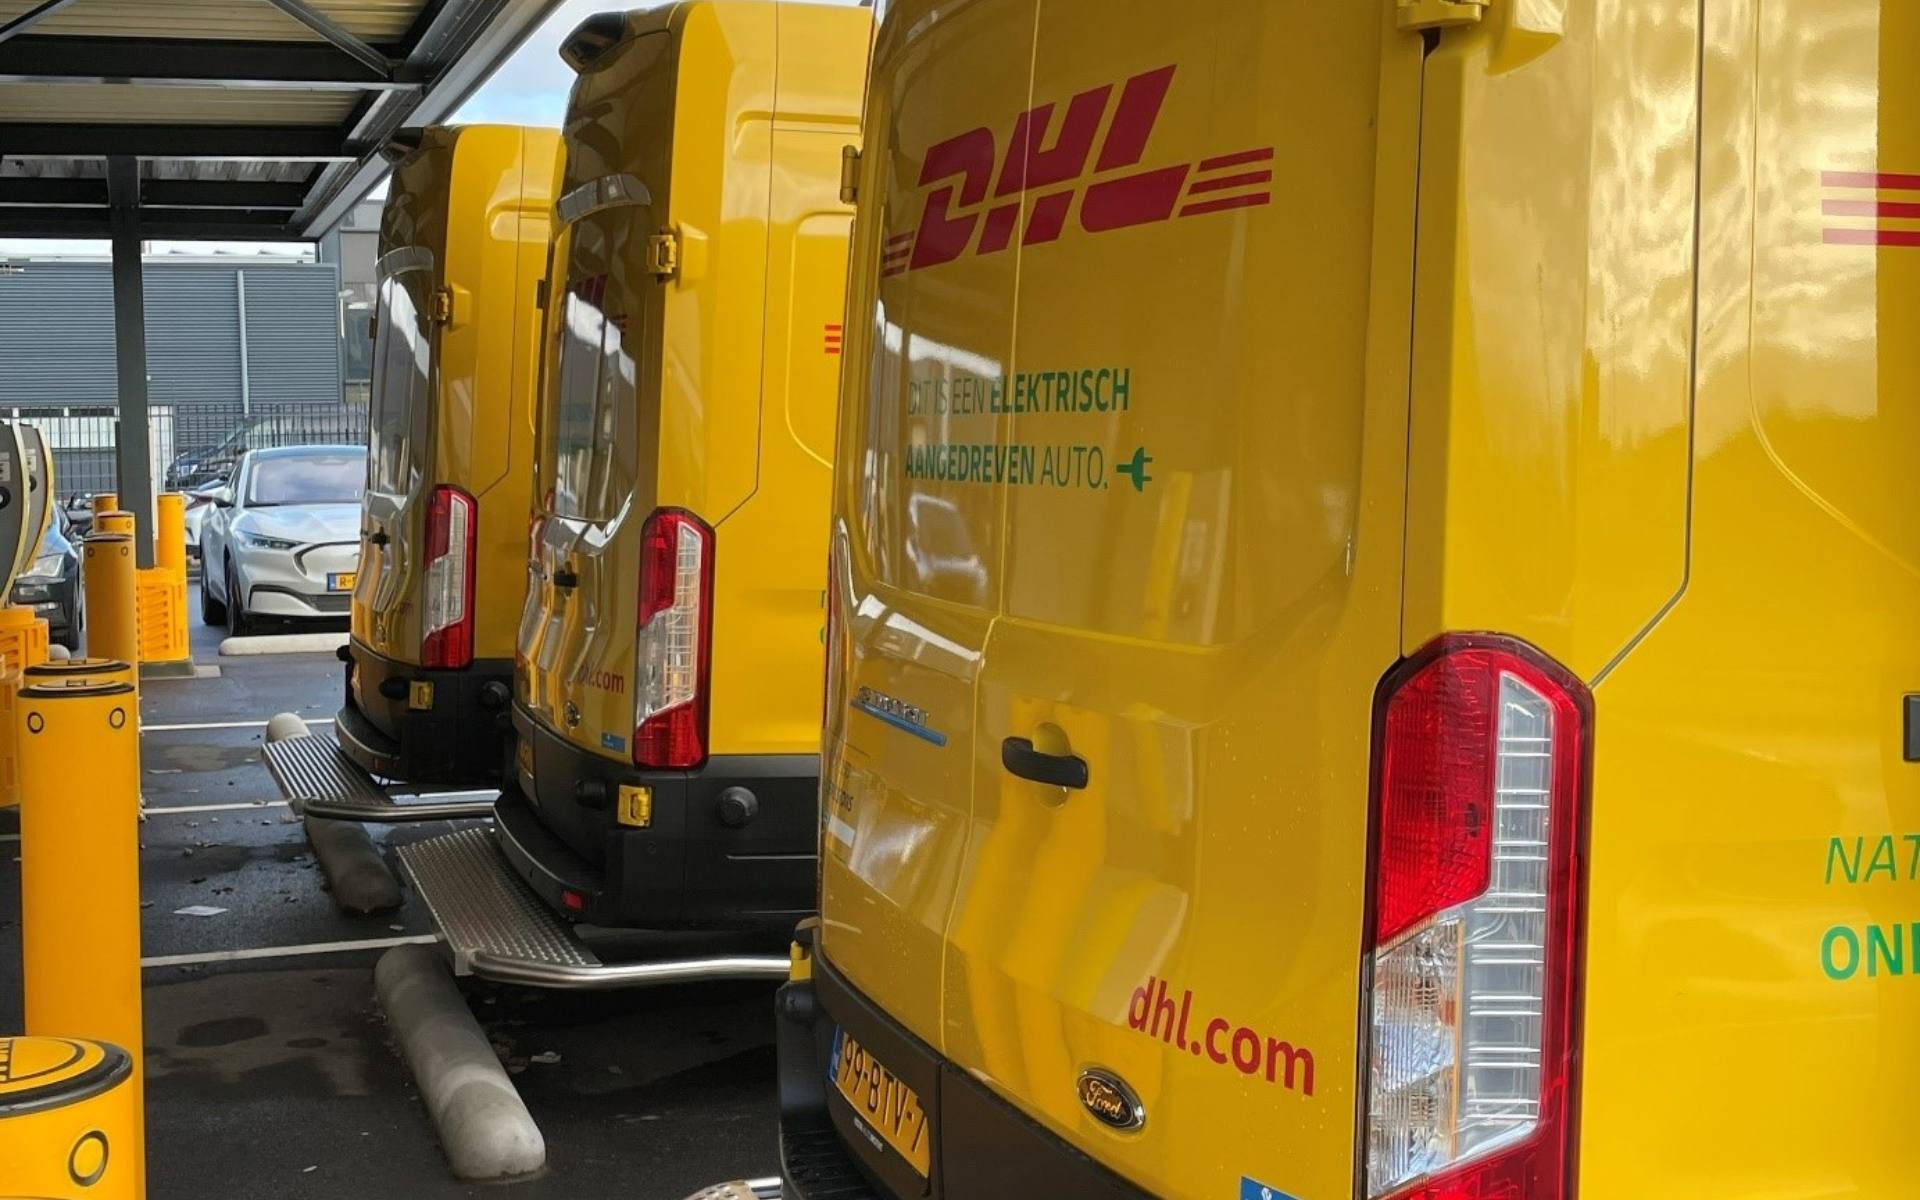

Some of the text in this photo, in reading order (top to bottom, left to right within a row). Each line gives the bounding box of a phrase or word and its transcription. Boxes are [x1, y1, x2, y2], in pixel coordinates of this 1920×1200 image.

[909, 64, 1190, 271] DHL
[952, 377, 985, 415] EEN
[990, 368, 1130, 413] ELEKTRISCH
[905, 444, 1109, 490] AANGEDREVEN AUTO.
[1820, 922, 1920, 981] ON
[1127, 975, 1315, 1097] dhl.com
[1085, 1079, 1123, 1119] Ford
